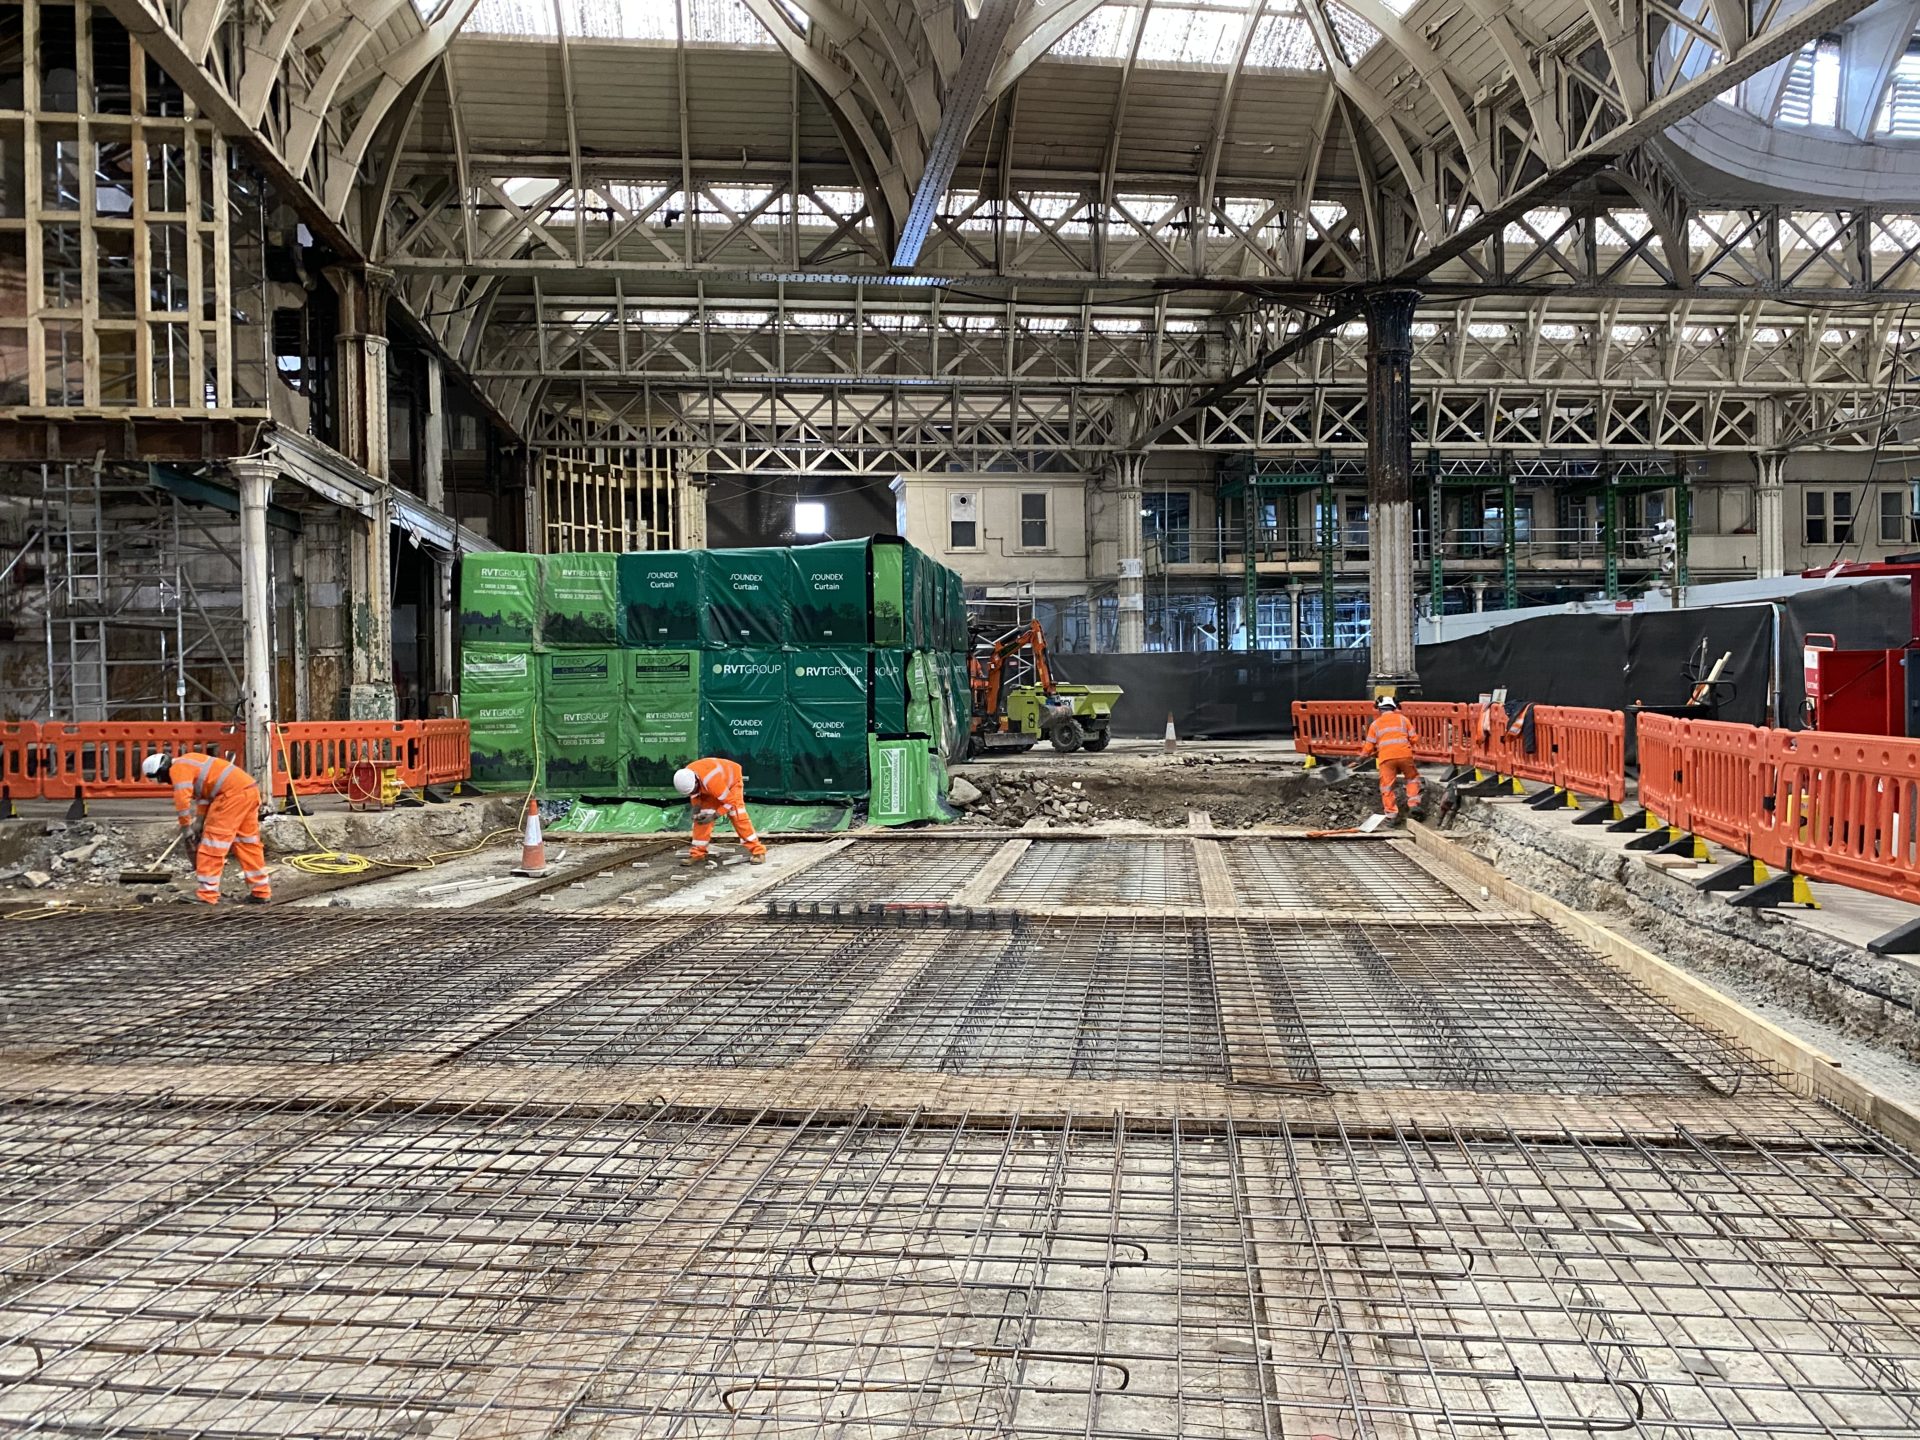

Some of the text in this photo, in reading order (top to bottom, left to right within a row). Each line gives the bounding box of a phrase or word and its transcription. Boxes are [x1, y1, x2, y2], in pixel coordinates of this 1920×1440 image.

[481, 568, 527, 577] RVTGROUP
[646, 571, 679, 579] SOUNDEX
[810, 573, 843, 581] SOUNDEX
[729, 573, 763, 582] SOUNDEX
[814, 582, 840, 590] Curtain
[723, 664, 782, 674] RVTGROUP
[806, 667, 863, 676] RVTGROUP
[480, 708, 525, 717] RVTGROUP
[563, 712, 609, 721] RVTGROUP
[729, 719, 763, 727] SOUNDEX
[811, 721, 844, 729] SOUNDEX
[815, 730, 841, 738] Curtain
[882, 769, 890, 810] SOUNDEX
